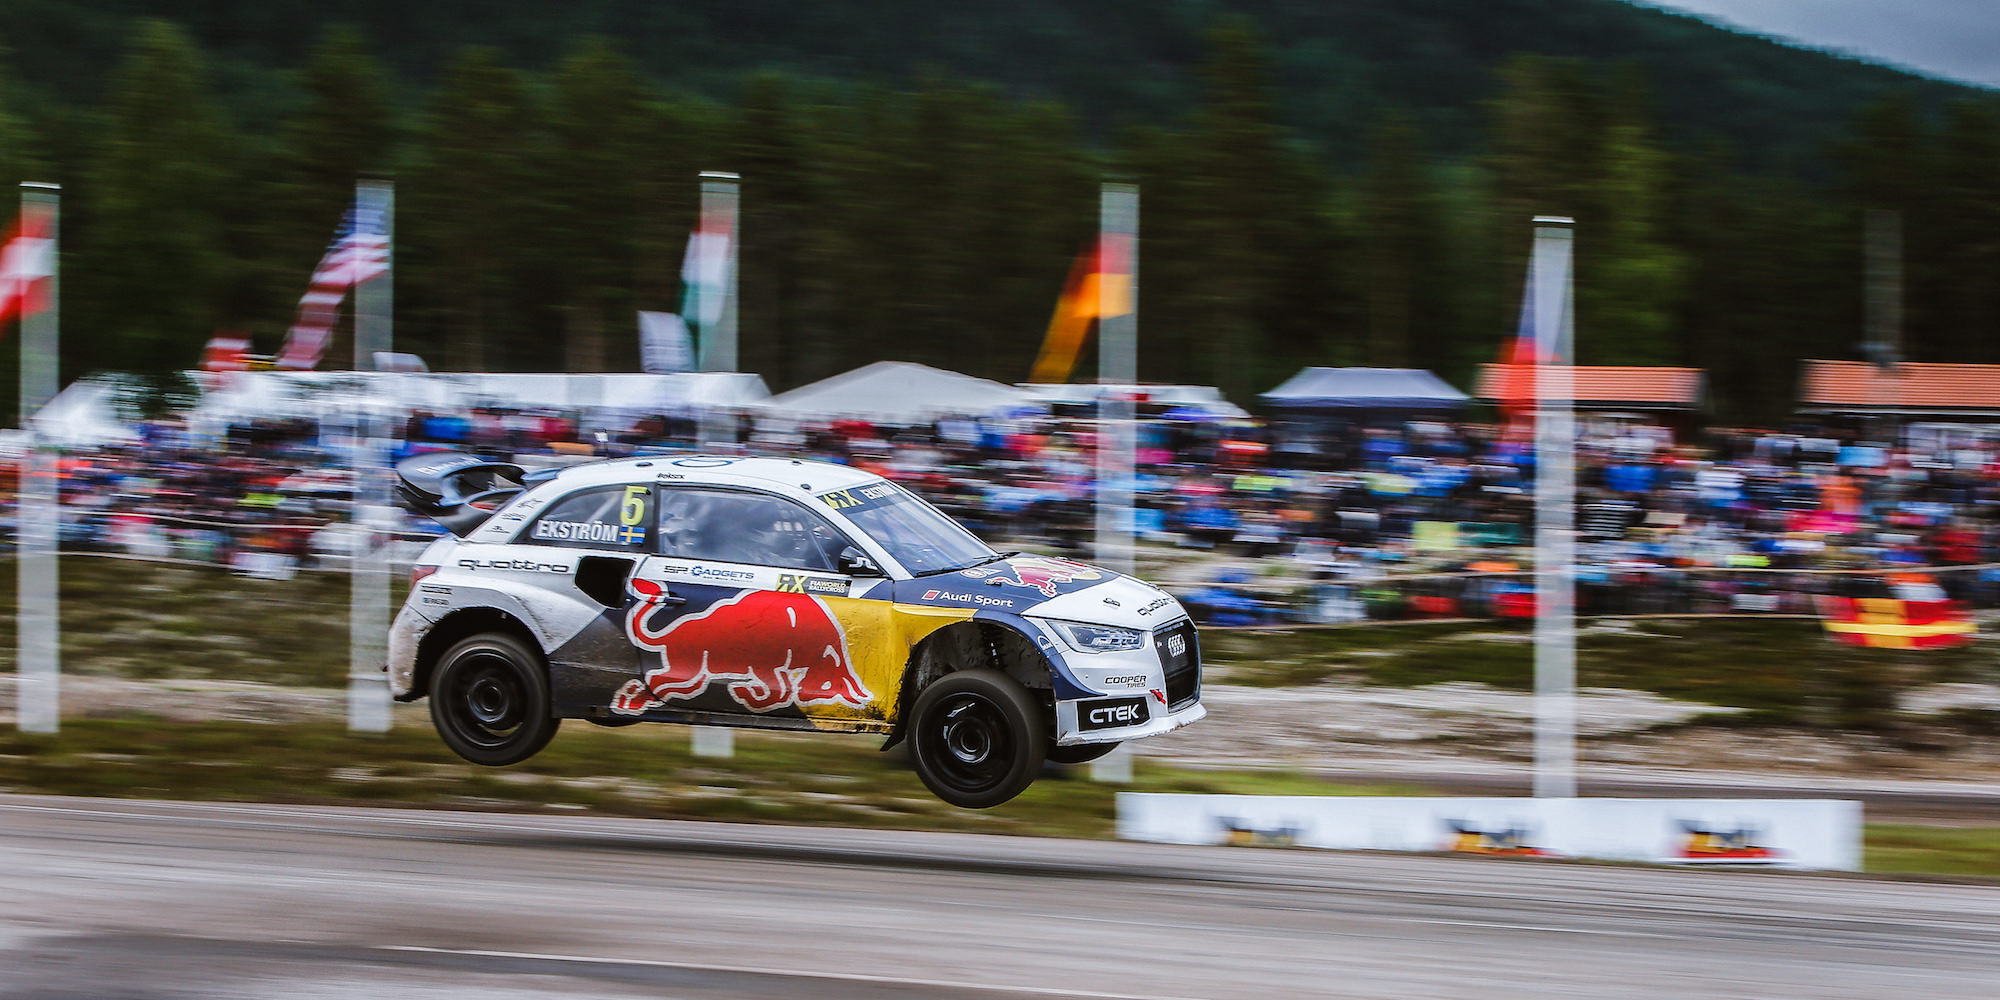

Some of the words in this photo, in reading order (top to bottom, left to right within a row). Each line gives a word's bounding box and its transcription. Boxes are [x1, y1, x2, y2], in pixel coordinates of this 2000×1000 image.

[620, 485, 648, 526] 5
[535, 519, 619, 542] EKSTRÖM
[458, 558, 570, 572] quattro
[690, 566, 755, 579] GADGETS
[940, 591, 972, 602] Audi
[974, 594, 1013, 607] Sport
[1105, 675, 1147, 684] COOPER
[1089, 703, 1140, 724] CTEK
